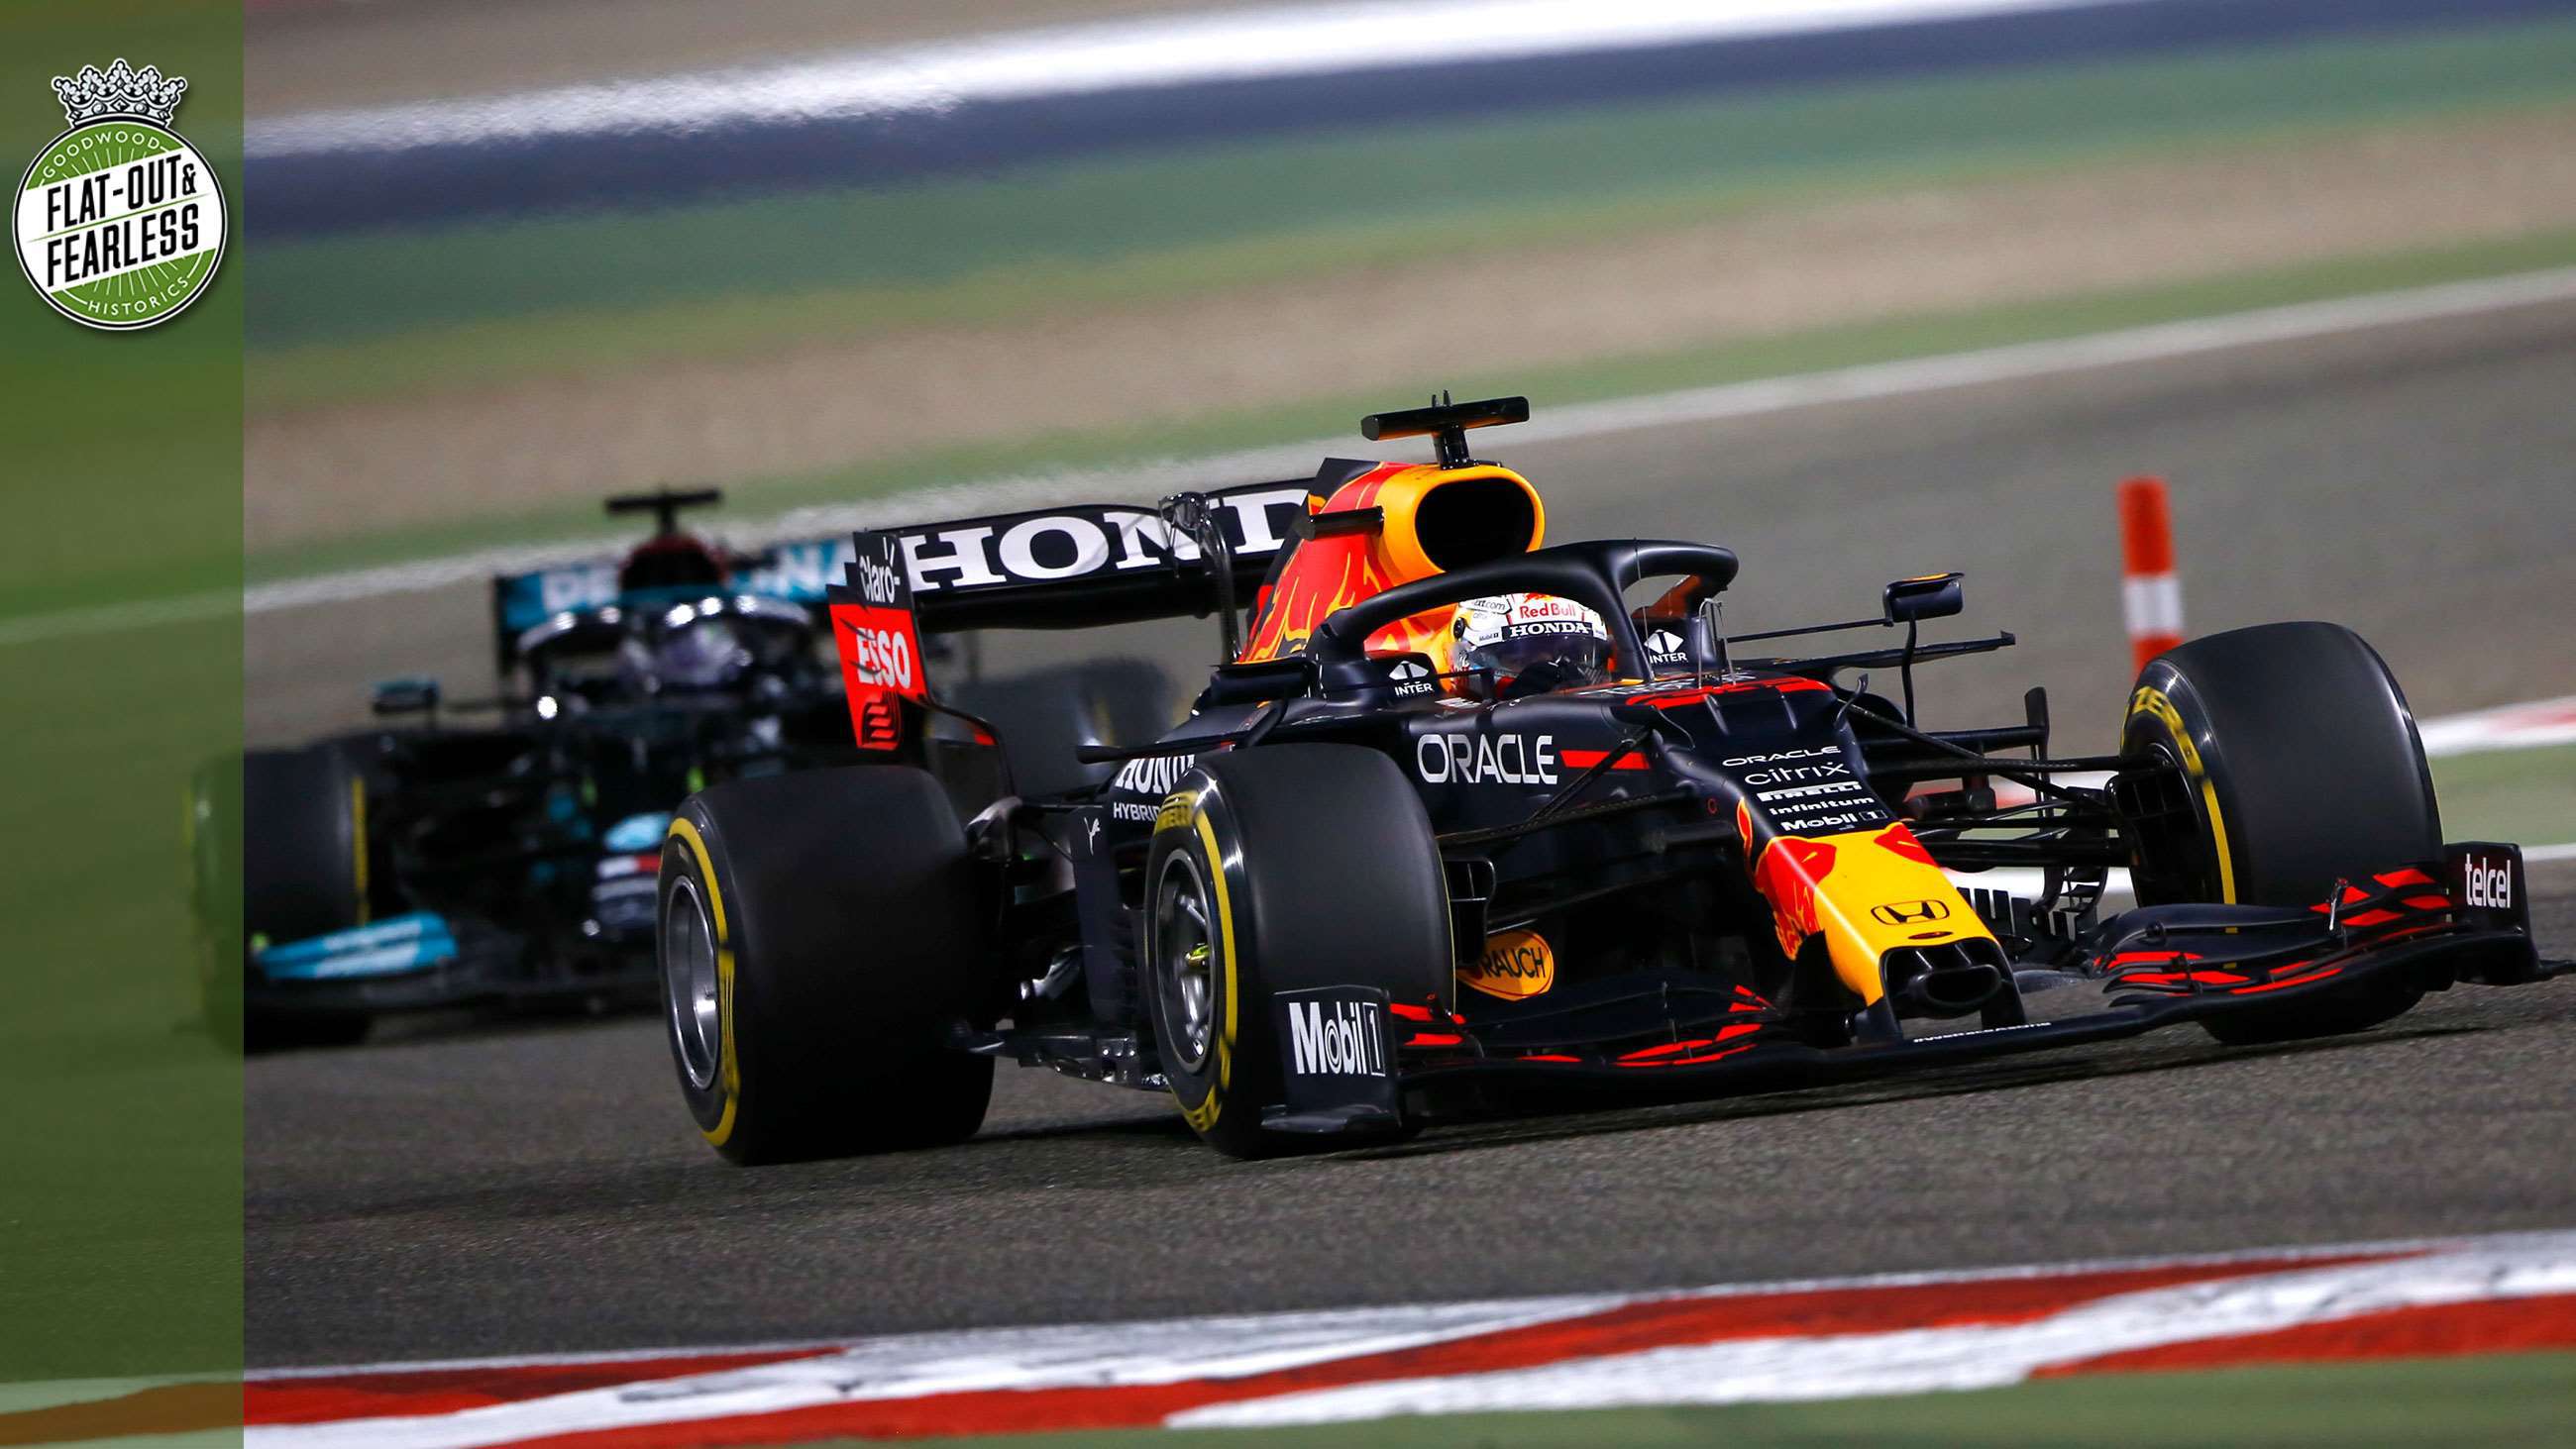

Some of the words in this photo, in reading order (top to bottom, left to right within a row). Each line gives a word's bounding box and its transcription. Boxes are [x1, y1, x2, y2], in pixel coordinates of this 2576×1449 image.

[1520, 603, 1549, 619] Red
[1552, 603, 1576, 617] Bull
[1509, 622, 1589, 637] HONDA
[856, 627, 912, 689] ESSO
[1649, 651, 1688, 664] INTER
[1394, 682, 1434, 696] INTER
[1417, 733, 1558, 785] ORACLE
[1722, 745, 1842, 767] ORACLE
[1756, 780, 1863, 802] PIRELLI
[1780, 813, 1859, 832] Mobil
[2464, 853, 2512, 909] telcel
[1288, 1001, 1367, 1075] Mobil
